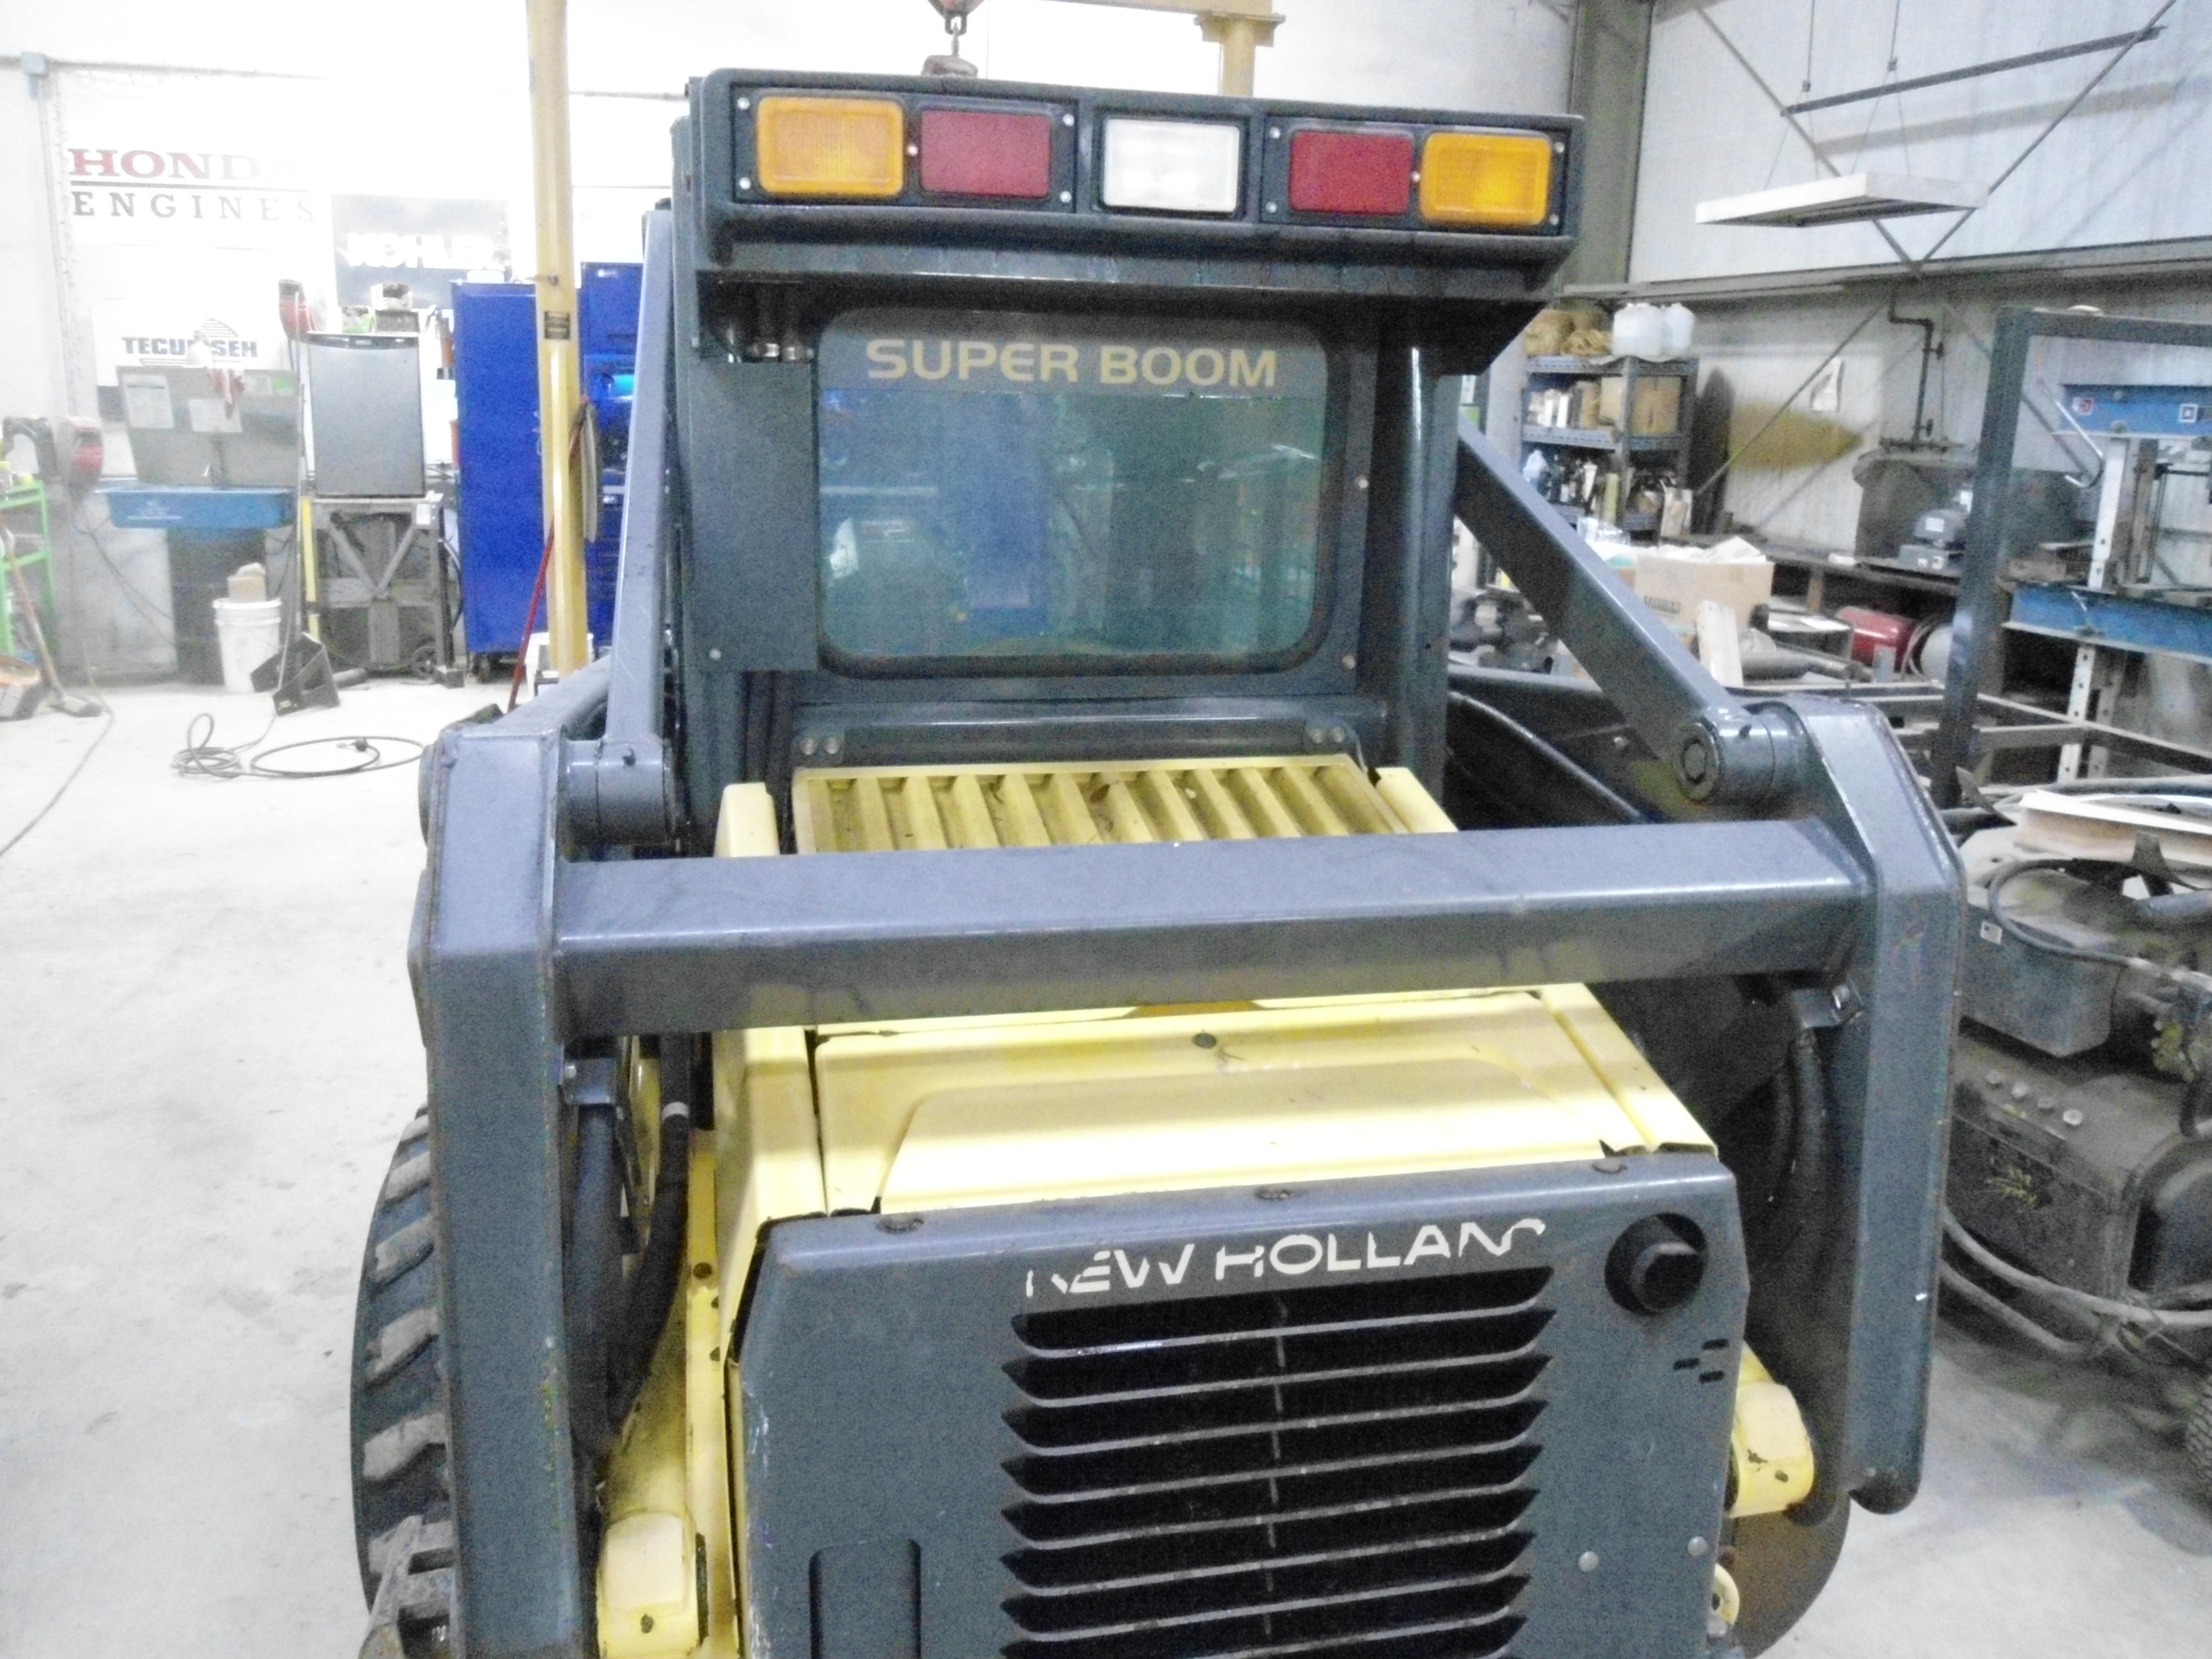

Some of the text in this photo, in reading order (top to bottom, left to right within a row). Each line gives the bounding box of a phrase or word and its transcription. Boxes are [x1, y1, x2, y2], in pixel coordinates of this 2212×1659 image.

[67, 148, 301, 181] HONDA
[71, 191, 314, 222] ENGINES
[122, 337, 258, 357] TECUSEH
[866, 339, 1276, 387] SUPER BOOM
